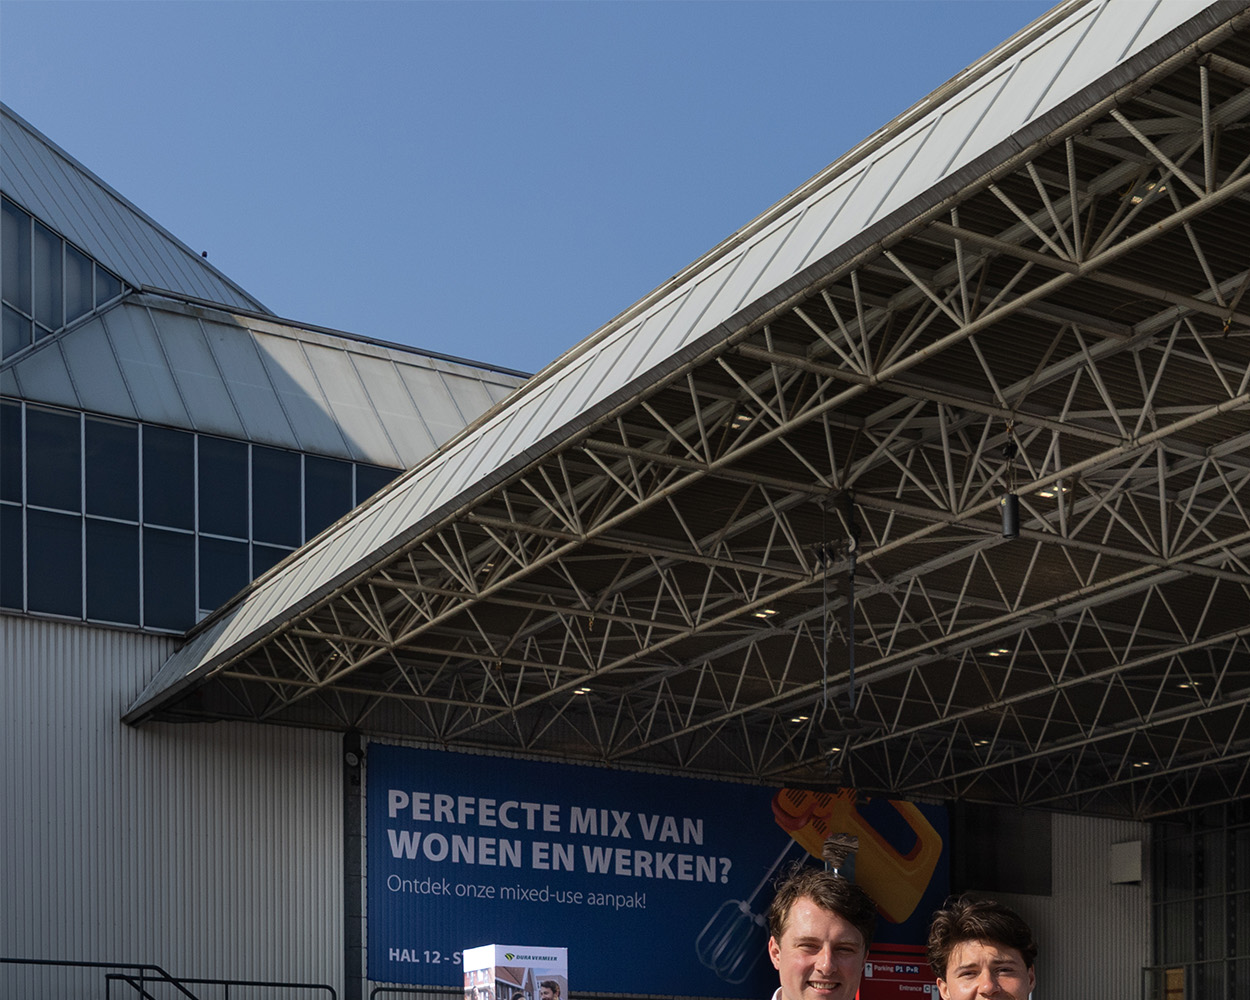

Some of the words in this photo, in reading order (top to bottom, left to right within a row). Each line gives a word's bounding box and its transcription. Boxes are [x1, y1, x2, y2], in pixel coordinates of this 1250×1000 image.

[388, 790, 560, 832] PERFECTE
[570, 806, 631, 838] MIX
[638, 813, 704, 845] VAN
[388, 829, 521, 868] WONEN
[532, 843, 575, 872] EN
[582, 845, 732, 884] WERKEN?
[388, 875, 451, 895] Ontdek
[456, 883, 495, 899] onze
[500, 883, 583, 905] mixed-use
[587, 893, 646, 911] aanpak!
[389, 948, 420, 963] HAL
[424, 951, 441, 964] 12
[453, 952, 464, 964] S
[874, 965, 894, 973] Parking
